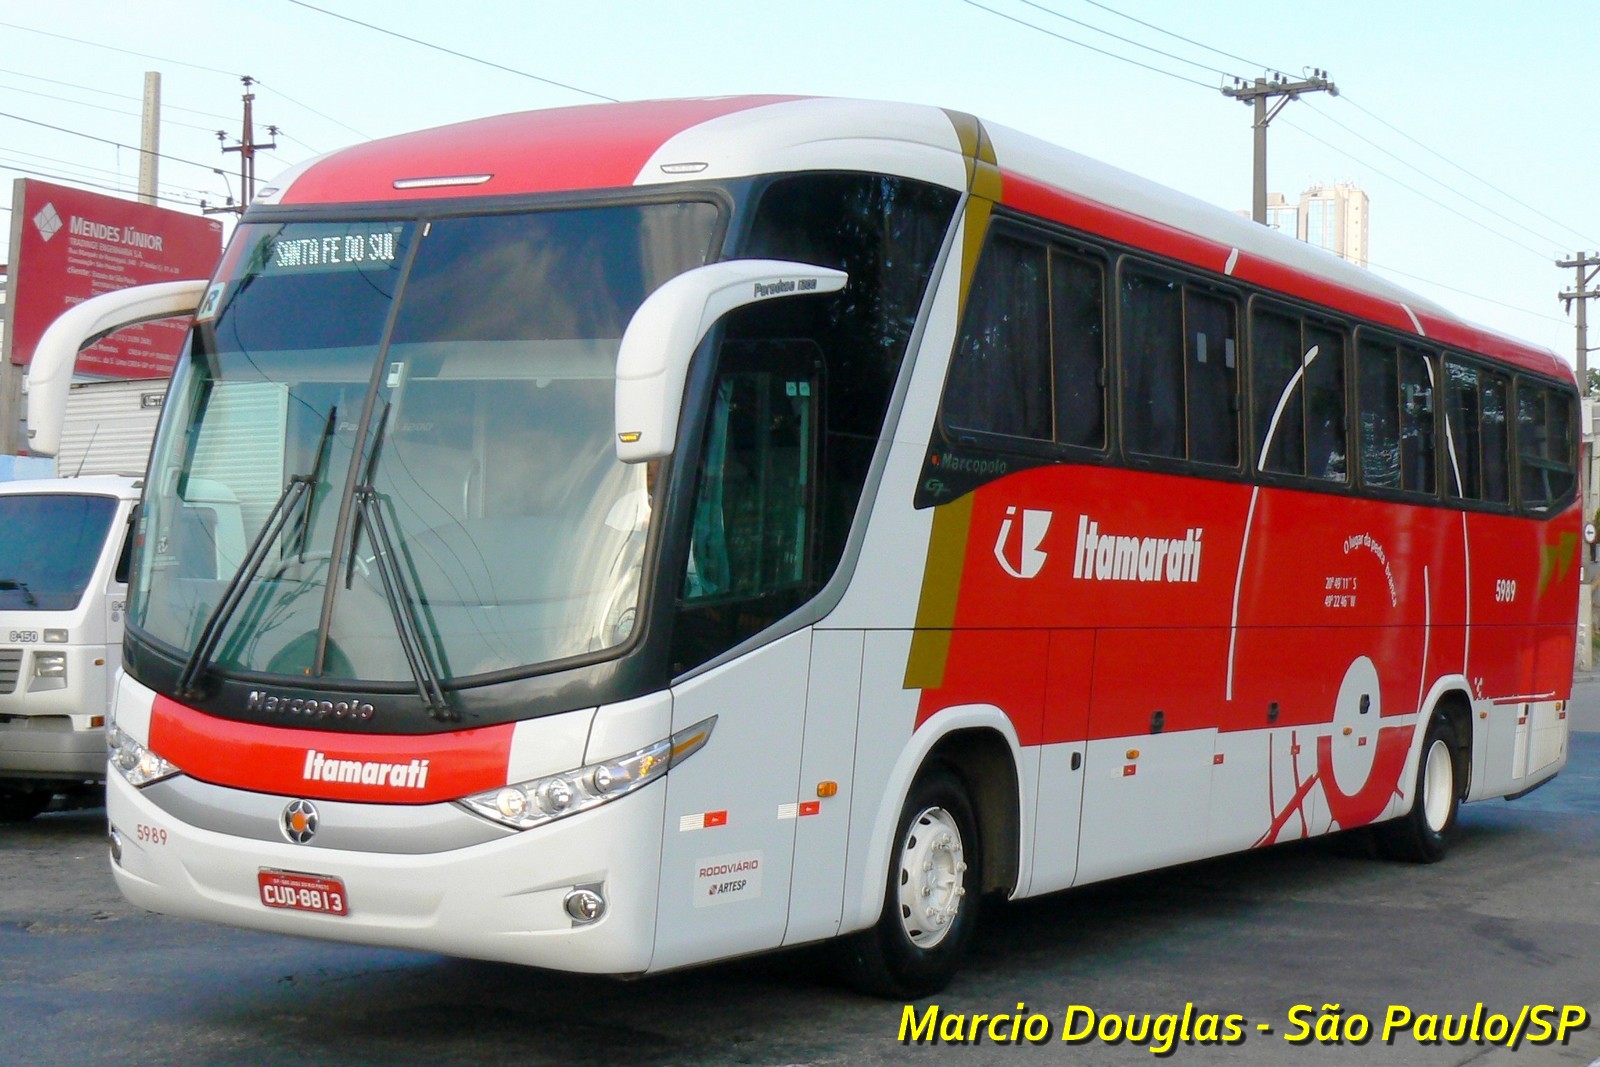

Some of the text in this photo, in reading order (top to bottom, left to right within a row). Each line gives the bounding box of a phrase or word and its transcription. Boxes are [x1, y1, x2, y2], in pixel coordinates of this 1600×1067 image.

[70, 216, 163, 252] MENDES JÚNIOR
[276, 232, 395, 267] SANTA FE DO SUL
[941, 452, 1007, 475] Marcopolo
[1495, 579, 1516, 602] 5989
[9, 630, 38, 642] 8-150
[247, 690, 375, 721] Marcopolo
[137, 823, 168, 846] 5989
[699, 859, 759, 878] RODOVIÁRIO
[264, 885, 343, 911] CUD-8813
[717, 879, 747, 894] ARTESP
